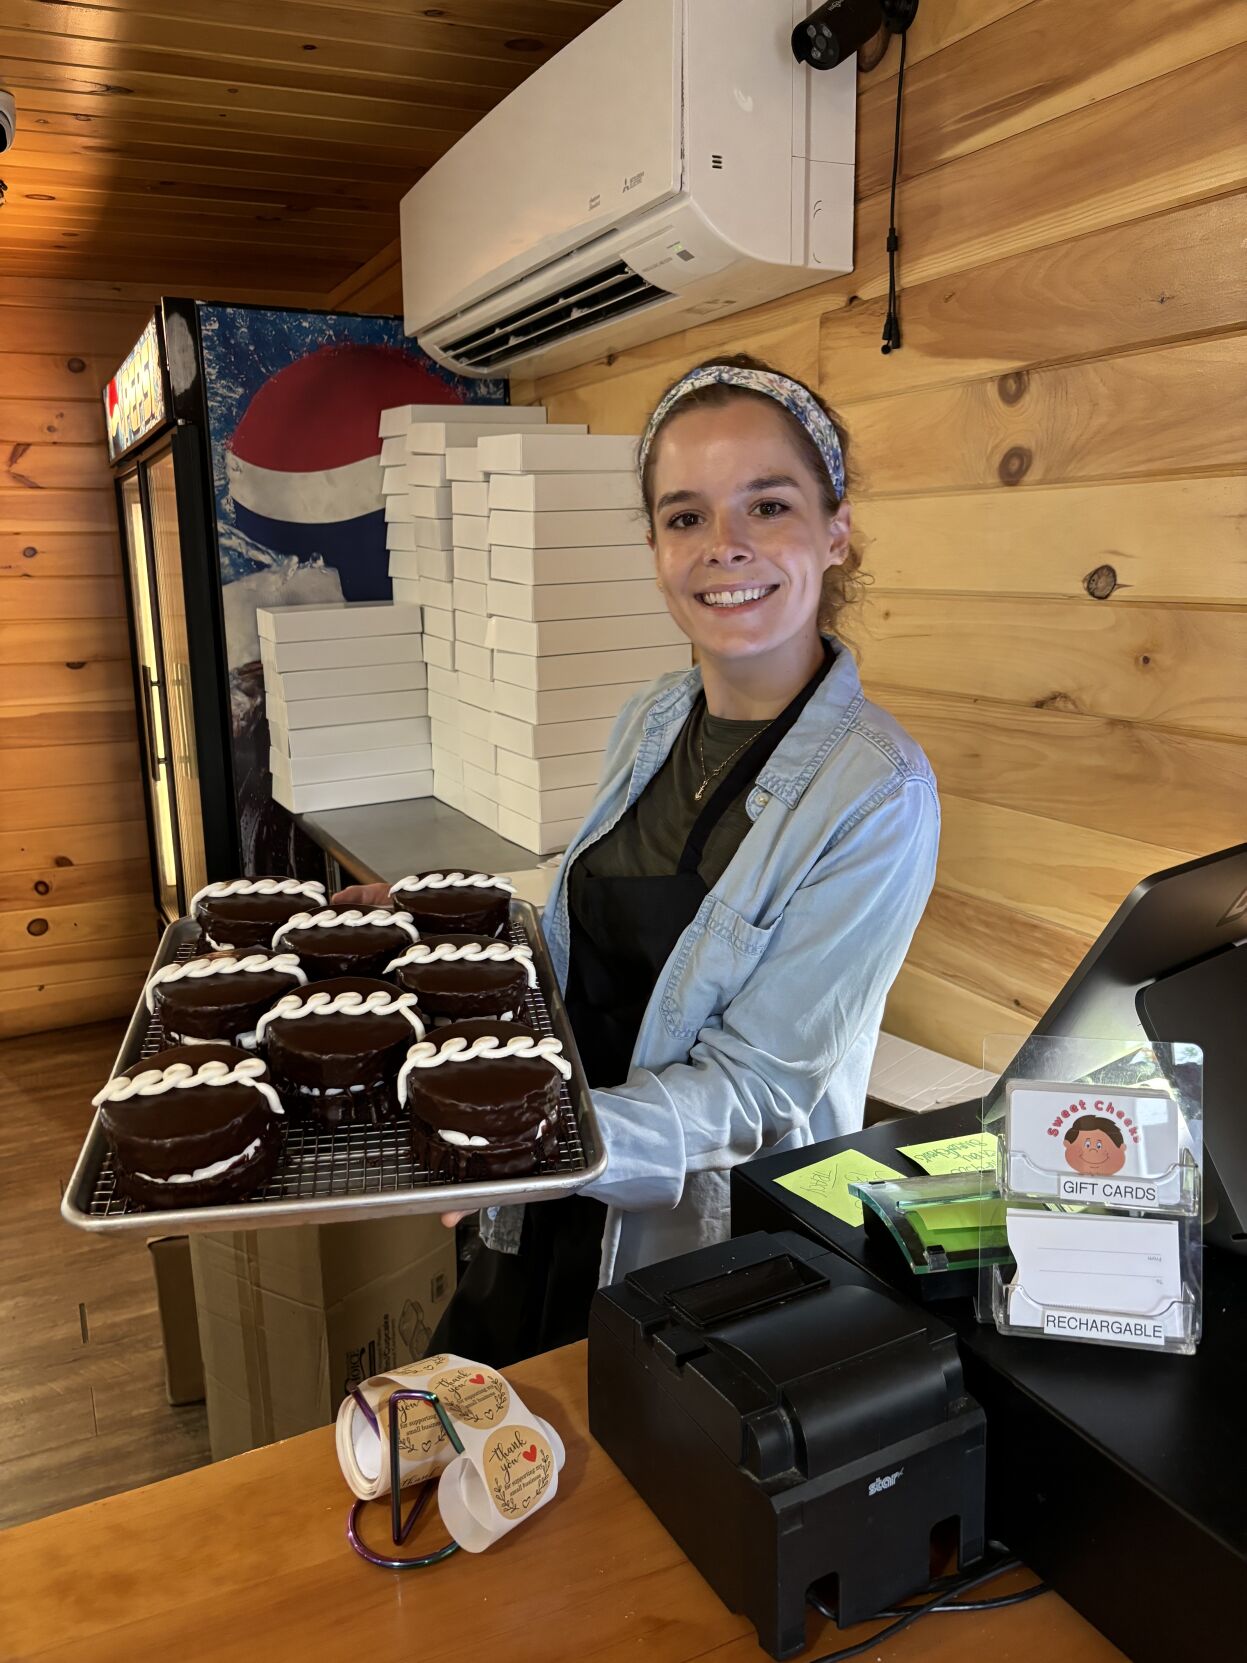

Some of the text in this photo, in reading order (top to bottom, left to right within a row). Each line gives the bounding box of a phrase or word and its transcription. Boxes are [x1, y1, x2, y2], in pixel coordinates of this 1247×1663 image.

[1047, 1099, 1139, 1144] Sweet Cheeks
[1063, 1180, 1156, 1201] GIFT CARDS
[1045, 1314, 1163, 1339] RECHARGABLE
[489, 1431, 527, 1463] thank
[868, 1470, 901, 1496] star
